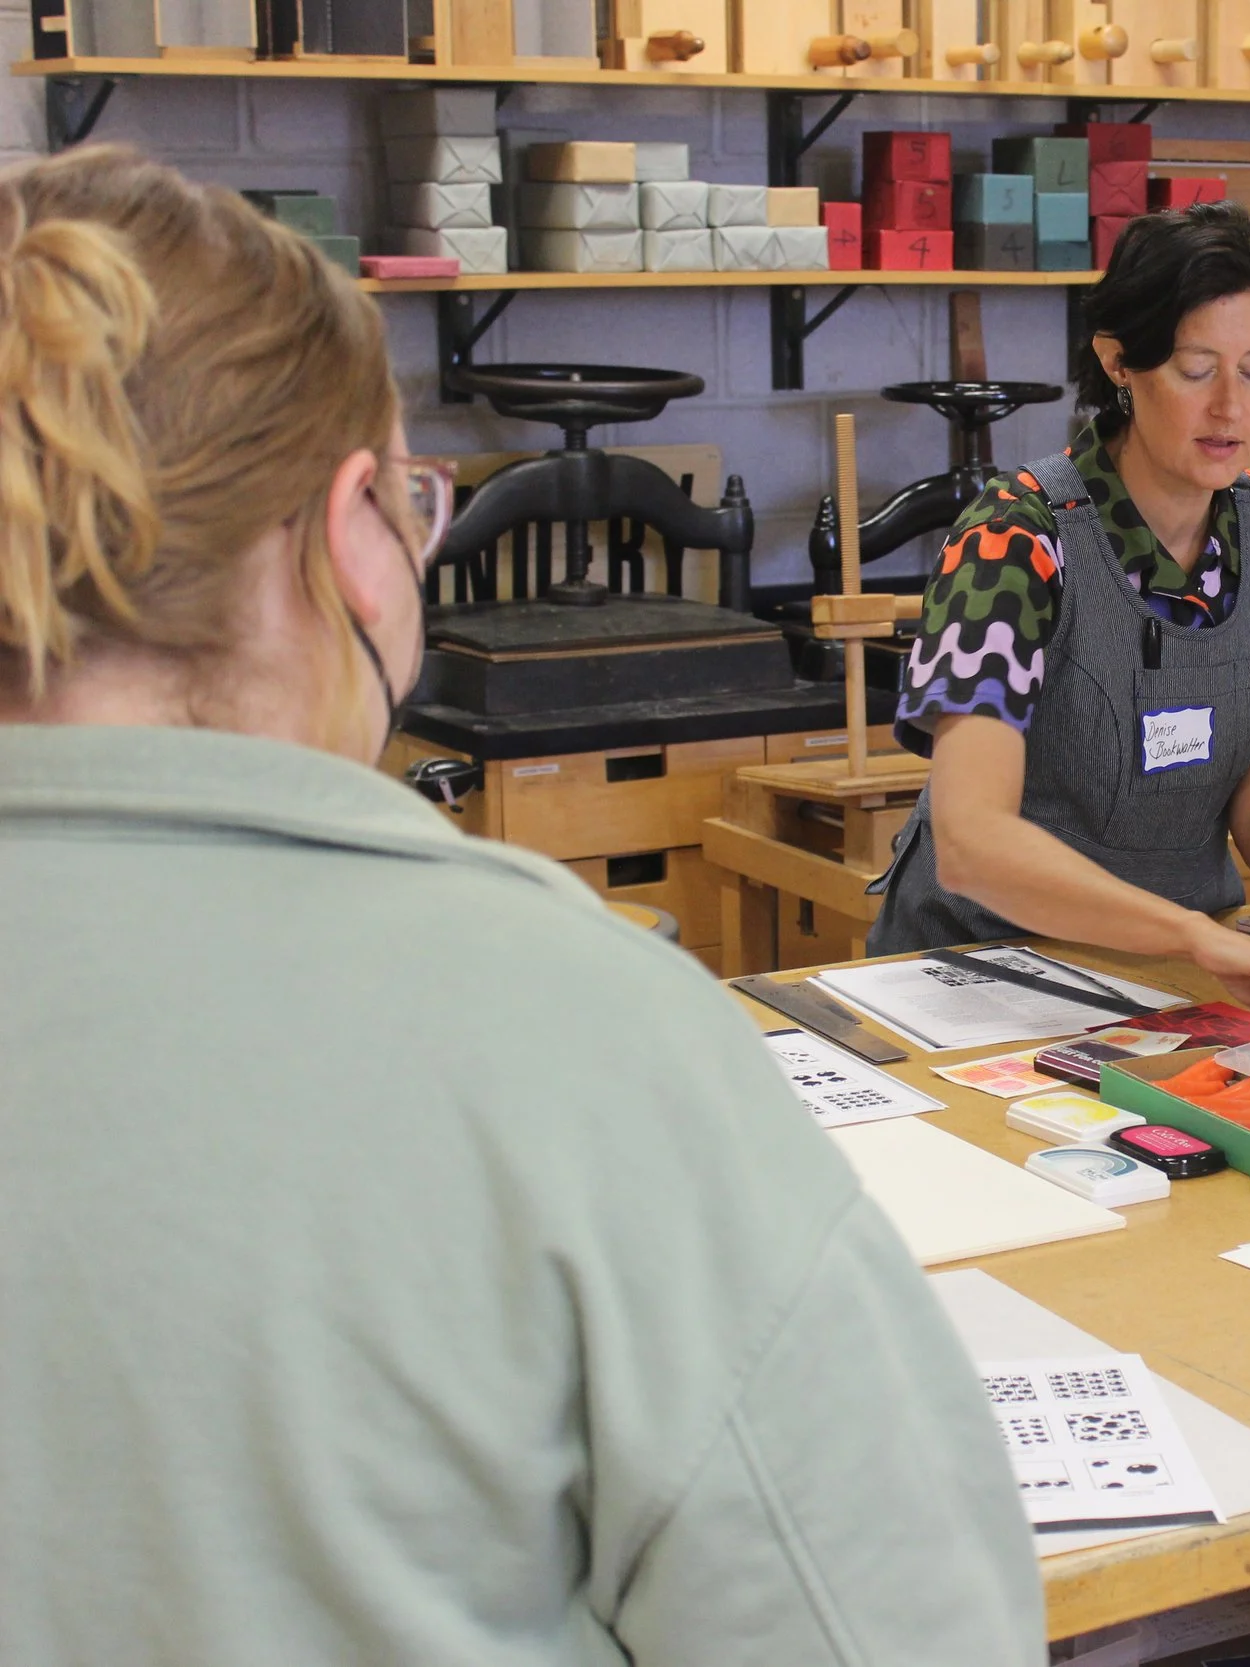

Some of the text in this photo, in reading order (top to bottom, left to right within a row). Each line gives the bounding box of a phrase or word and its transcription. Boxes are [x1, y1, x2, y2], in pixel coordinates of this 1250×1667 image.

[908, 236, 931, 268] 4
[1001, 232, 1024, 265] 4
[1146, 721, 1177, 741] Denise
